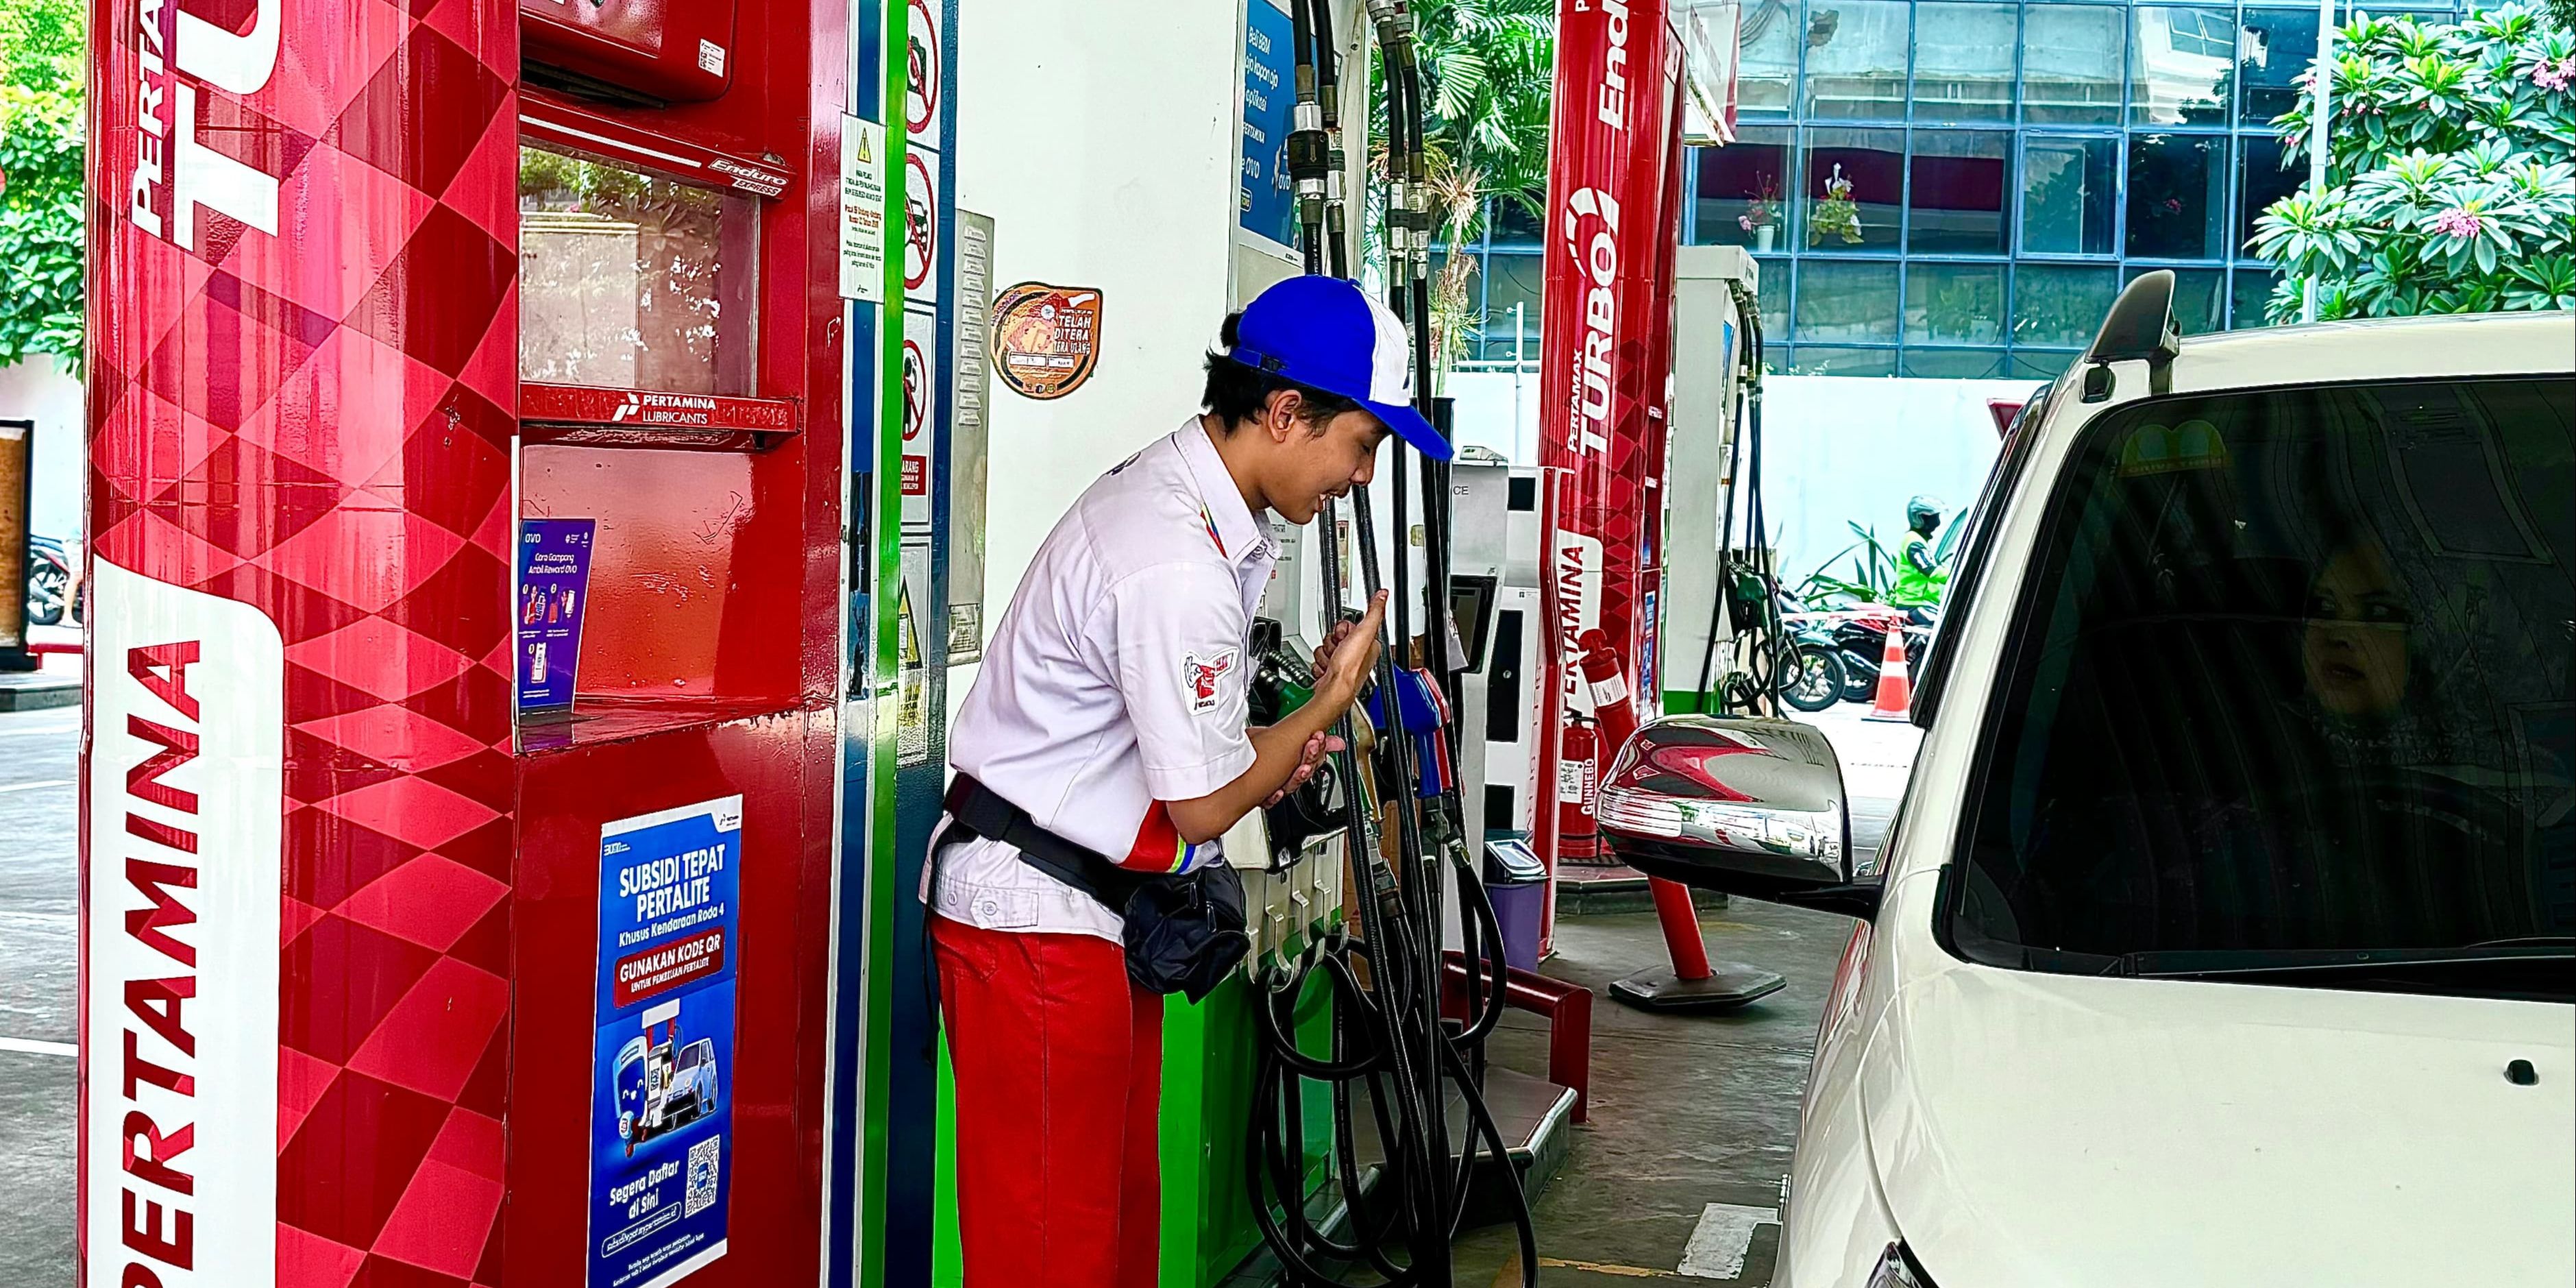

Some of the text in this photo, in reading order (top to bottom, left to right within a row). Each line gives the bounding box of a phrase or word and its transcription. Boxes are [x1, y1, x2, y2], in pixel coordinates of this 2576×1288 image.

[1598, 0, 1628, 130] End
[709, 158, 788, 186] Enduro
[736, 179, 779, 195] EXPRESS
[1246, 157, 1260, 180] OVO
[1059, 315, 1092, 328] TELAH
[1580, 231, 1619, 456] TURBO
[643, 395, 716, 410] PERTAMINA
[643, 411, 708, 424] LUBRICANTS
[1567, 349, 1582, 452] PERTAMAX
[525, 533, 541, 543] OVO
[1581, 758, 1595, 815] GUNNEBO
[620, 844, 726, 898] SUBSIDI TEPAT
[637, 876, 709, 923] PERTALITE
[619, 902, 724, 947] Khusus Kendaraan Roda 4
[620, 934, 720, 982] GUNAKAN KODE QR
[610, 1160, 679, 1206] Segera Daftar
[628, 1188, 659, 1219] di Sini
